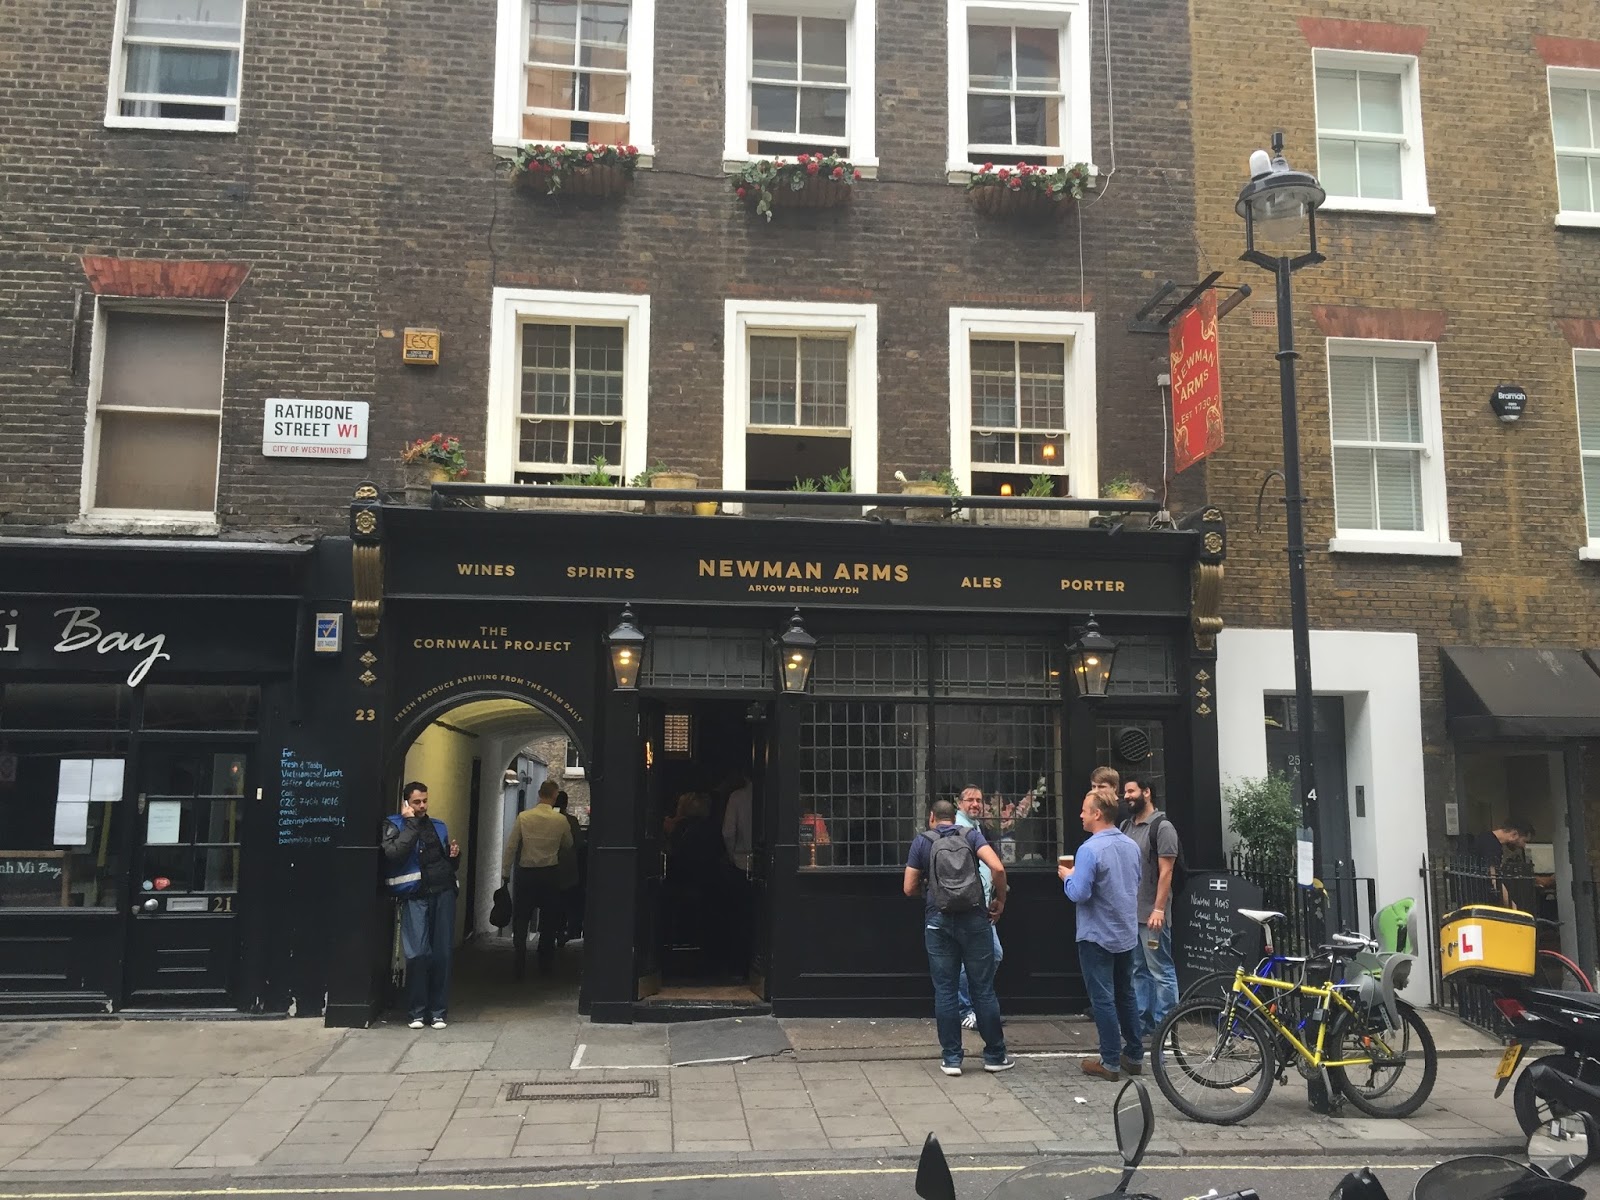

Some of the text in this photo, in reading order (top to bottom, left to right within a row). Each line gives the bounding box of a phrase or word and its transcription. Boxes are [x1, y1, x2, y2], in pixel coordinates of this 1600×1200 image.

[1174, 349, 1215, 394] NEWMAN
[1180, 369, 1209, 404] ARMS
[1498, 392, 1526, 400] Bramah
[275, 404, 353, 420] RATHBONE
[1181, 412, 1193, 425] EST
[274, 422, 358, 438] STREET W1
[272, 445, 288, 453] CITY
[301, 447, 352, 455] WESTMINSTER
[457, 559, 1126, 593] WINES SPIRITS NEWMAN ARMS ALES PORTER
[748, 584, 860, 595] ARVOW DEN-NOWYDH
[480, 626, 508, 637] THE
[0, 606, 170, 688] i Bay
[413, 639, 572, 652] CORNWALL PROJECT
[394, 674, 583, 723] FRESH PRODUCE ARRIVING FROM THE FARM DAILY
[355, 708, 376, 721] 23
[281, 760, 299, 768] Fresh
[1288, 754, 1301, 766] 25
[323, 769, 344, 778] Lunch
[1307, 788, 1318, 801] 4
[16, 861, 35, 874] Mi
[38, 862, 62, 880] Bay
[213, 897, 232, 912] 21
[1462, 933, 1474, 954] L
